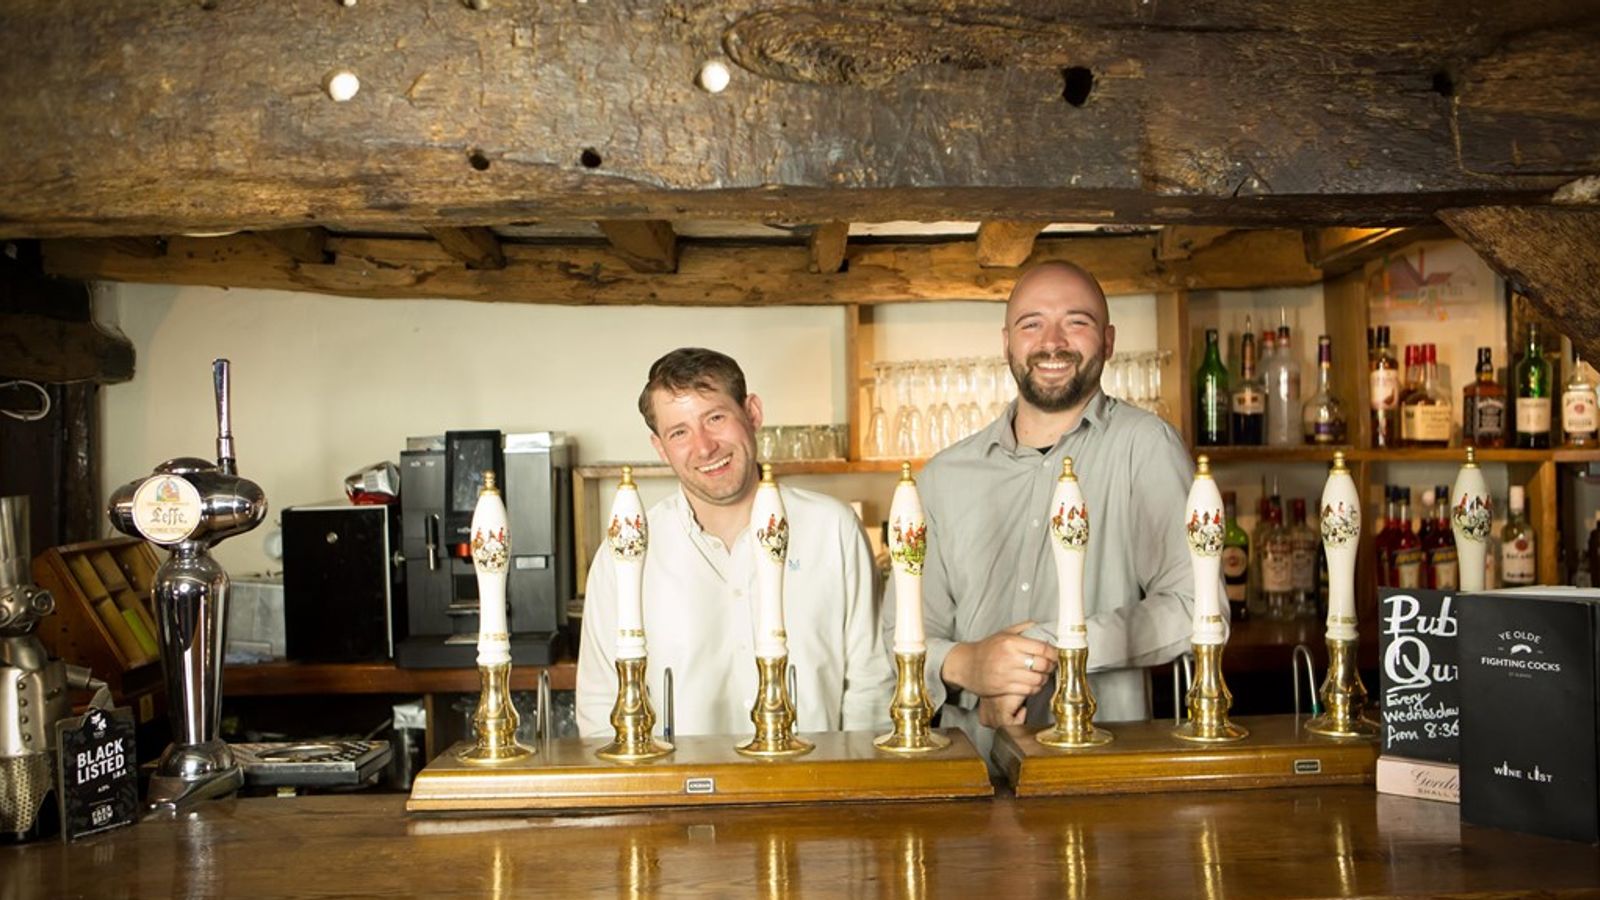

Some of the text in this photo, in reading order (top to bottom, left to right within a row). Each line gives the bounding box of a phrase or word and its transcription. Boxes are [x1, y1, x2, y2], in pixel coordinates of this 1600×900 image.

[1383, 594, 1458, 638] Pub
[1498, 630, 1541, 644] YE OLDE
[1481, 656, 1561, 672] FIGHTING COCKS
[1386, 692, 1431, 711] Every
[1387, 724, 1419, 749] from
[77, 738, 124, 769] BLACK
[77, 754, 125, 785] LISTED
[1493, 760, 1553, 782] WINE LIST
